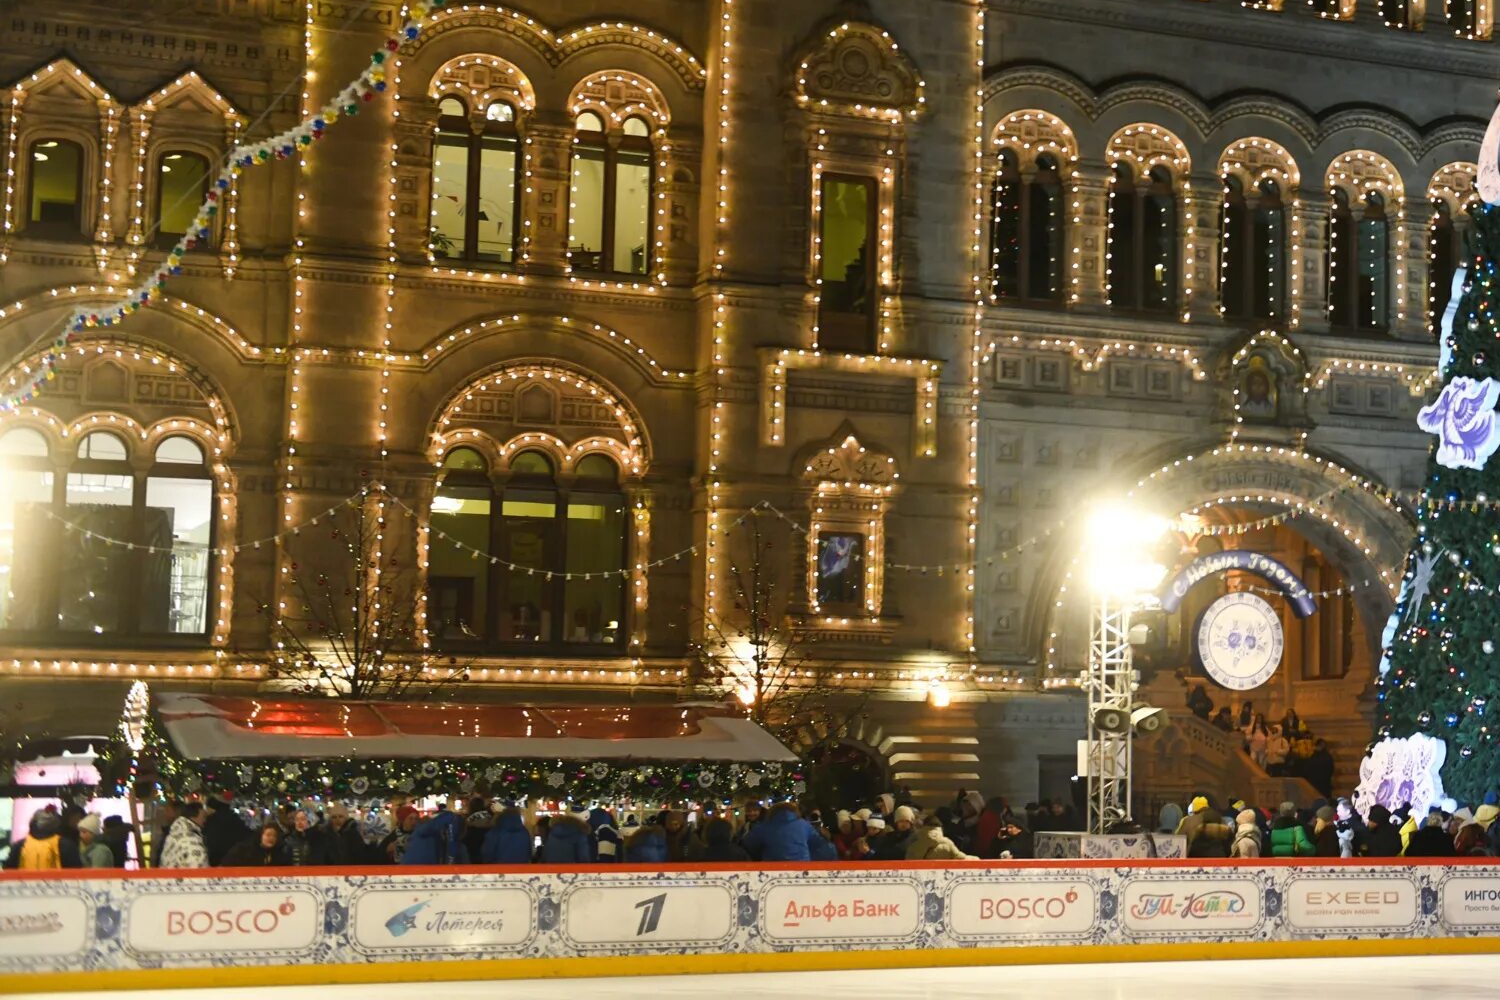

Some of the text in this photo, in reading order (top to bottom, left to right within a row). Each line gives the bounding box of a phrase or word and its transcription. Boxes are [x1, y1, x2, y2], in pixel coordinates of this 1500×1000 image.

[980, 898, 1065, 919] BOSCO
[1306, 892, 1400, 904] EXEED
[785, 900, 900, 922] Альфа Банк
[168, 909, 279, 935] BOSCO
